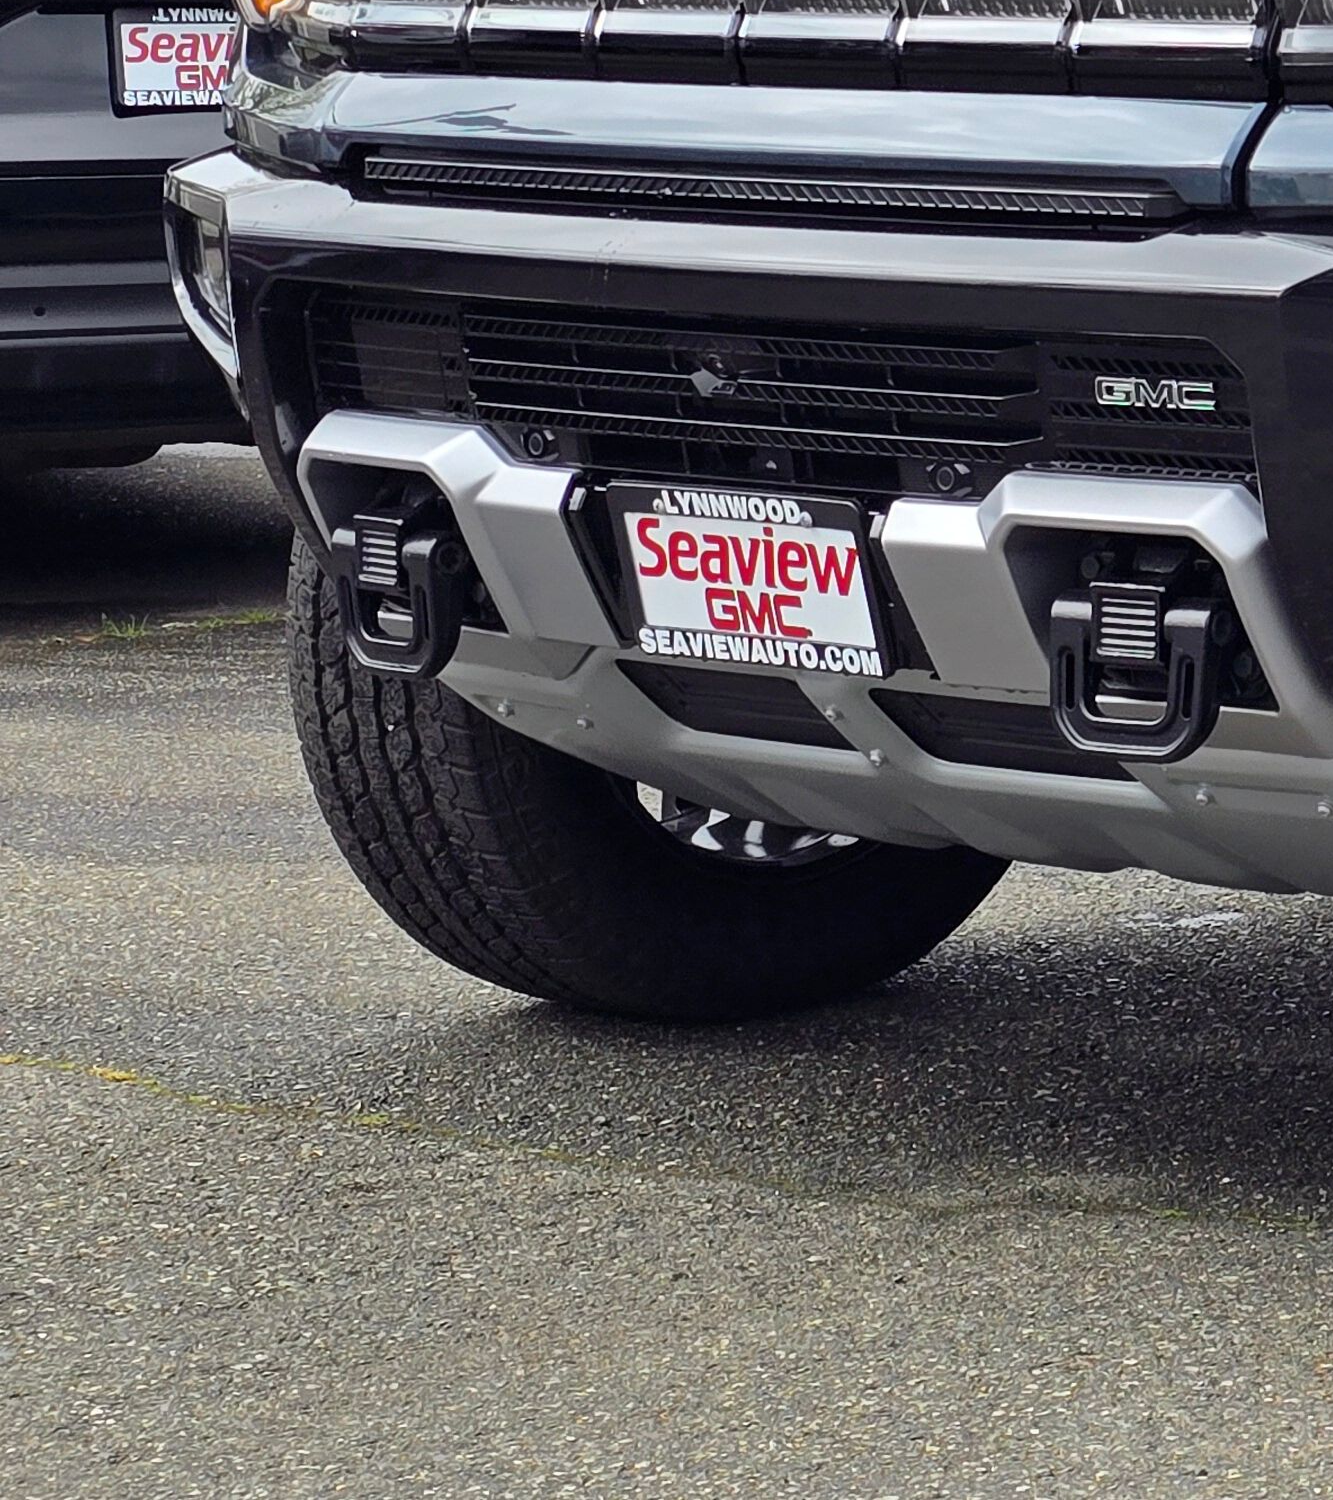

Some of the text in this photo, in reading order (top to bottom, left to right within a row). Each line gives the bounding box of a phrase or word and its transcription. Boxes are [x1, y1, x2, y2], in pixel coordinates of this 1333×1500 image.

[155, 7, 239, 22] LYNNWO
[125, 26, 235, 63] Seavi
[175, 65, 227, 90] GM
[123, 90, 224, 106] SEAVIEWA
[1095, 376, 1216, 411] GMC
[660, 490, 801, 525] LYNNWOOD
[637, 517, 860, 597] Seaview
[704, 587, 812, 639] GMC
[638, 626, 884, 677] SEAVIEWAUTO.COM
